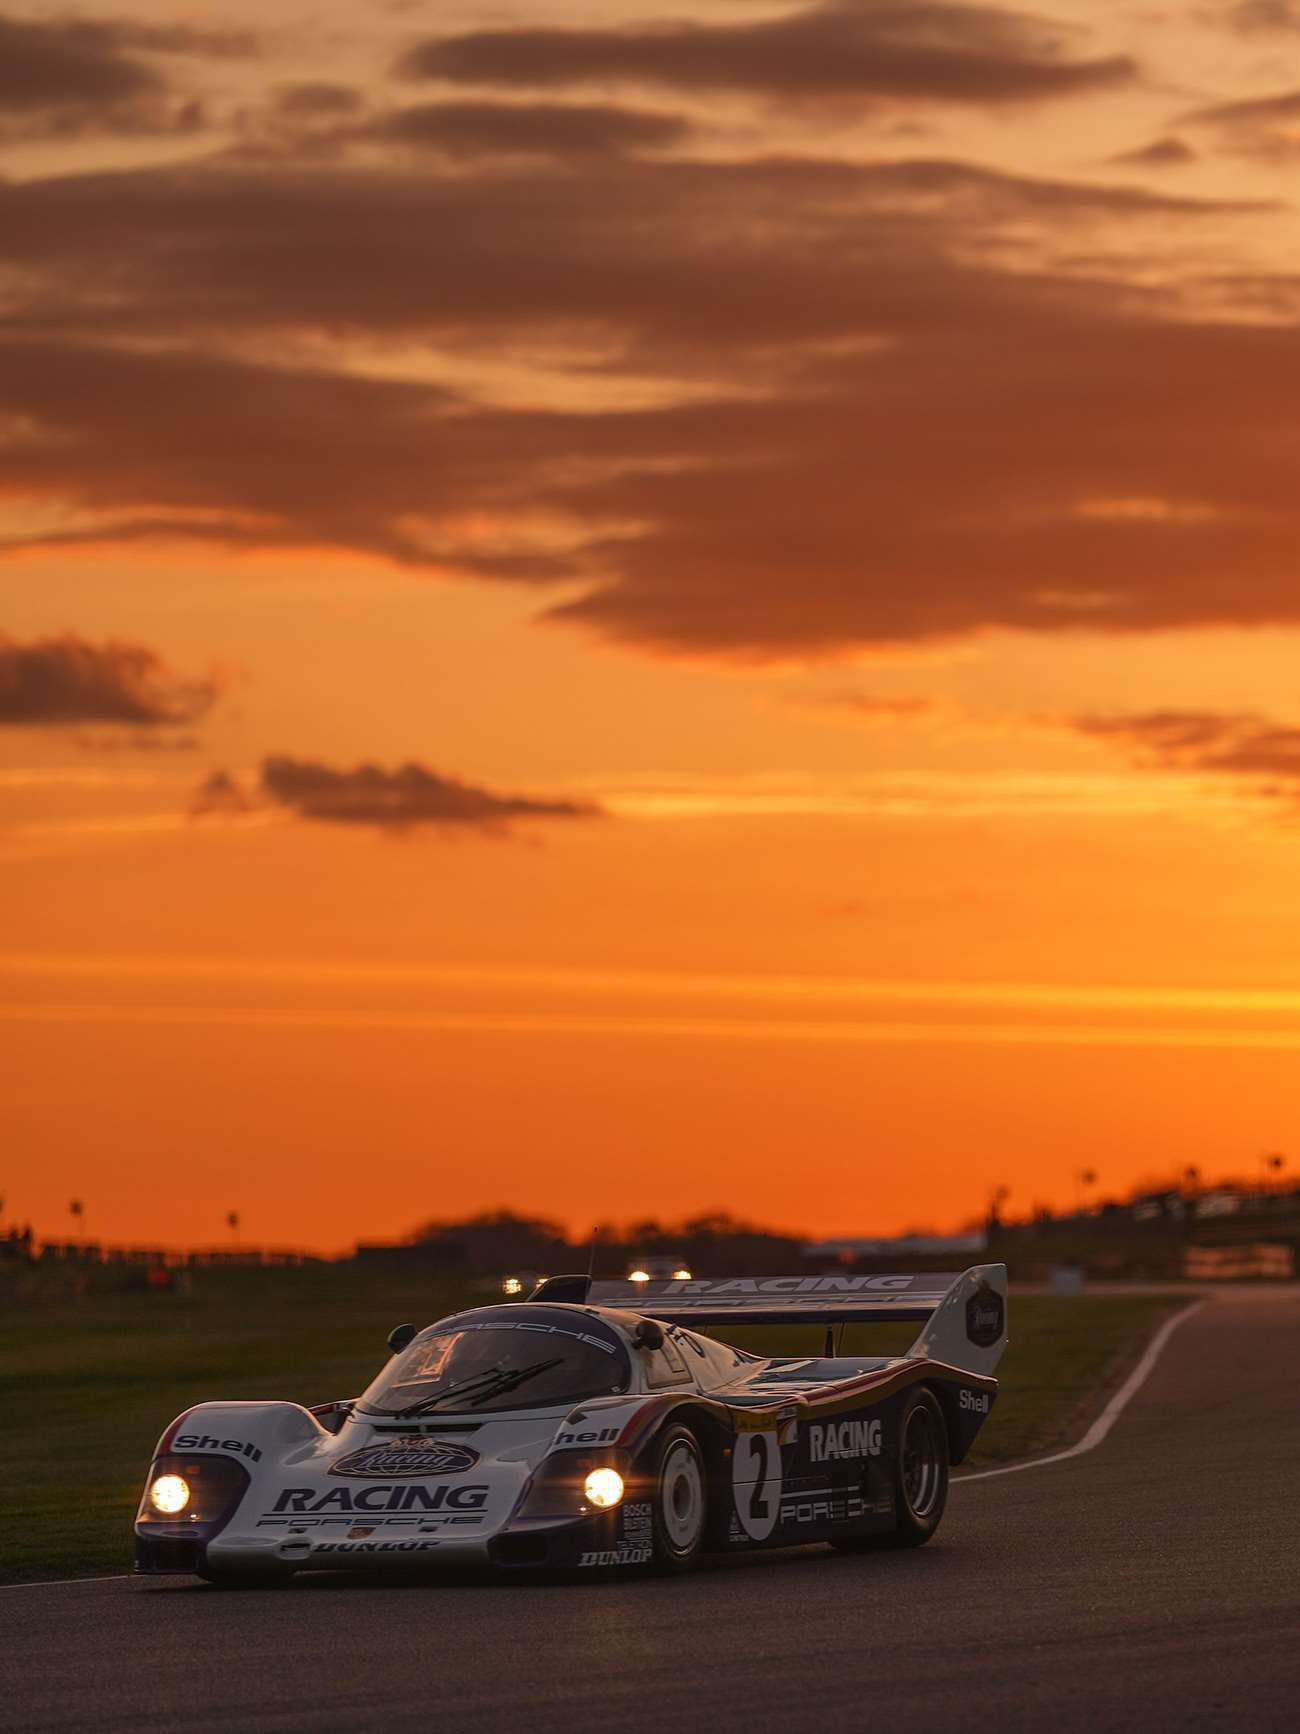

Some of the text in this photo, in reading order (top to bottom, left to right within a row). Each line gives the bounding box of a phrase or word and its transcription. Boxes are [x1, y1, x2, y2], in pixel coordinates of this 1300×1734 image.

[660, 1275, 914, 1294] RACING
[959, 1389, 988, 1413] Shell
[174, 1435, 262, 1462] Shell
[554, 1428, 619, 1445] hell
[809, 1418, 882, 1462] RACING
[750, 1434, 769, 1519] 2
[272, 1485, 489, 1512] RACING
[256, 1516, 484, 1527] PORSCHE
[577, 1547, 653, 1567] DUNLOP
